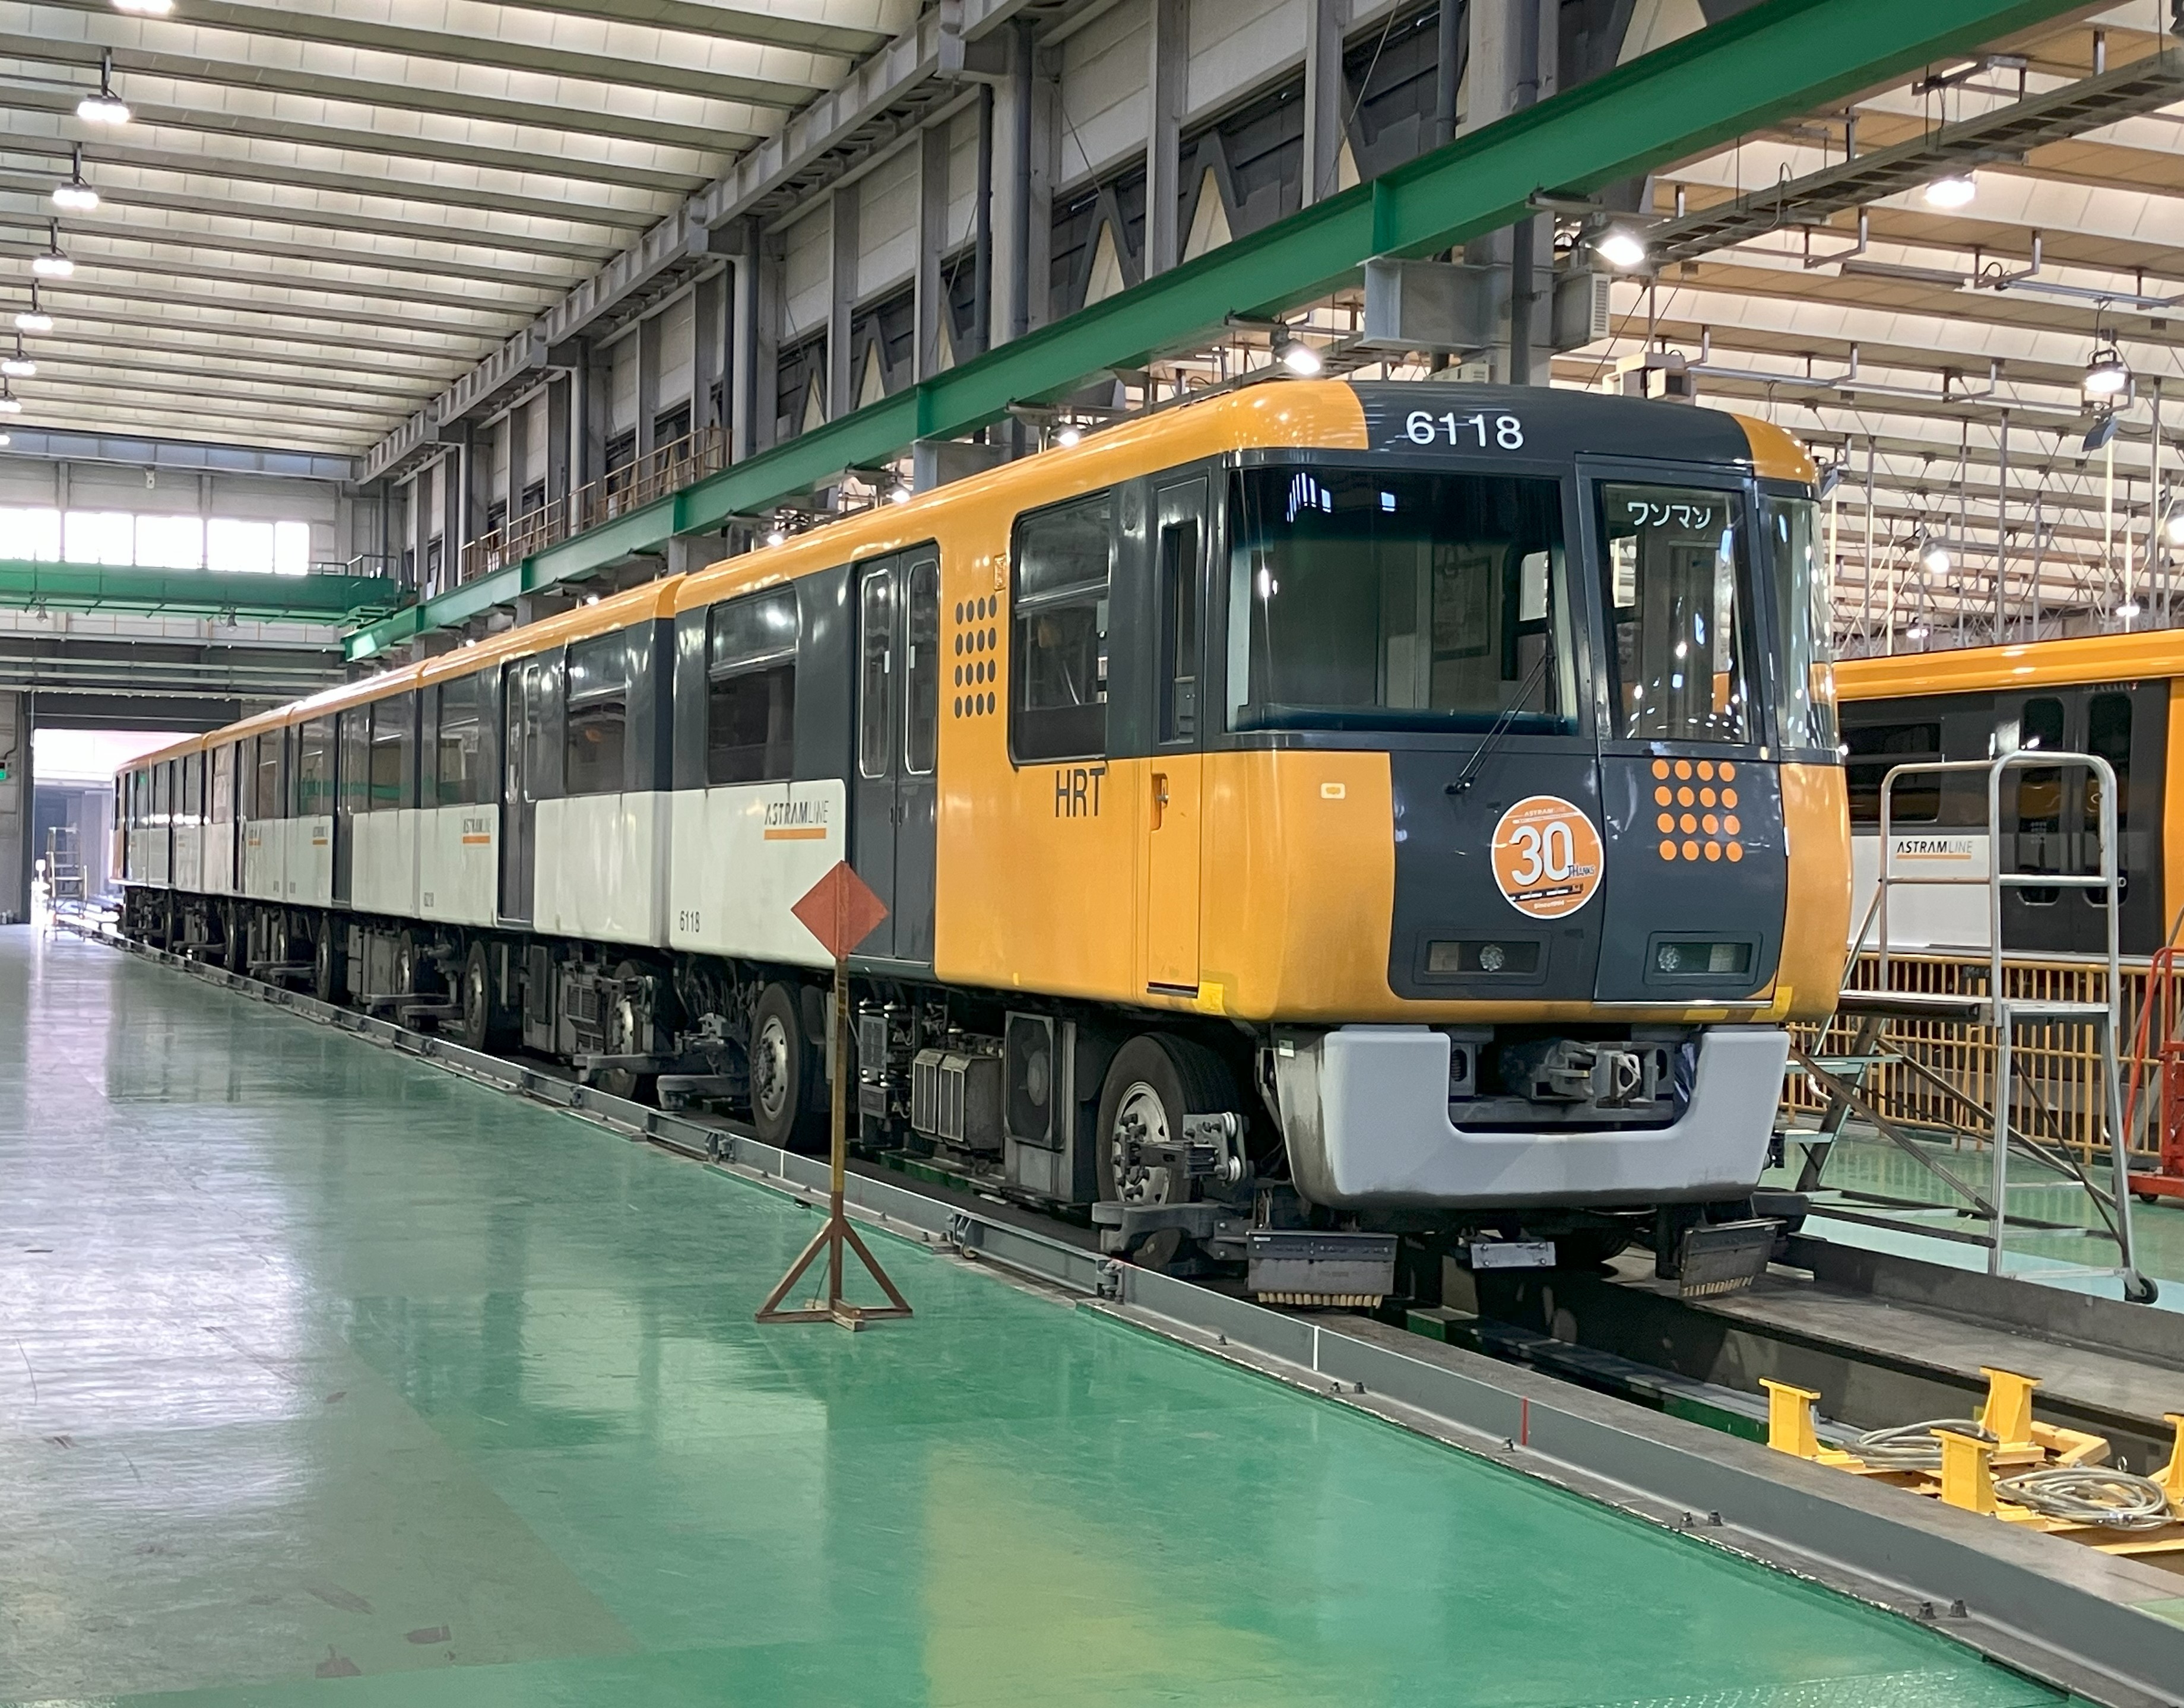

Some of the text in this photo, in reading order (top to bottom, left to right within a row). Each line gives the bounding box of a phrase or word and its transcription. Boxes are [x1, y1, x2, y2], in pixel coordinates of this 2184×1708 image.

[1405, 410, 1524, 450] 6118
[1627, 502, 1711, 530] ワンマン
[1055, 768, 1106, 818] HRT
[1508, 821, 1574, 886] 30
[679, 910, 700, 933] 6118
